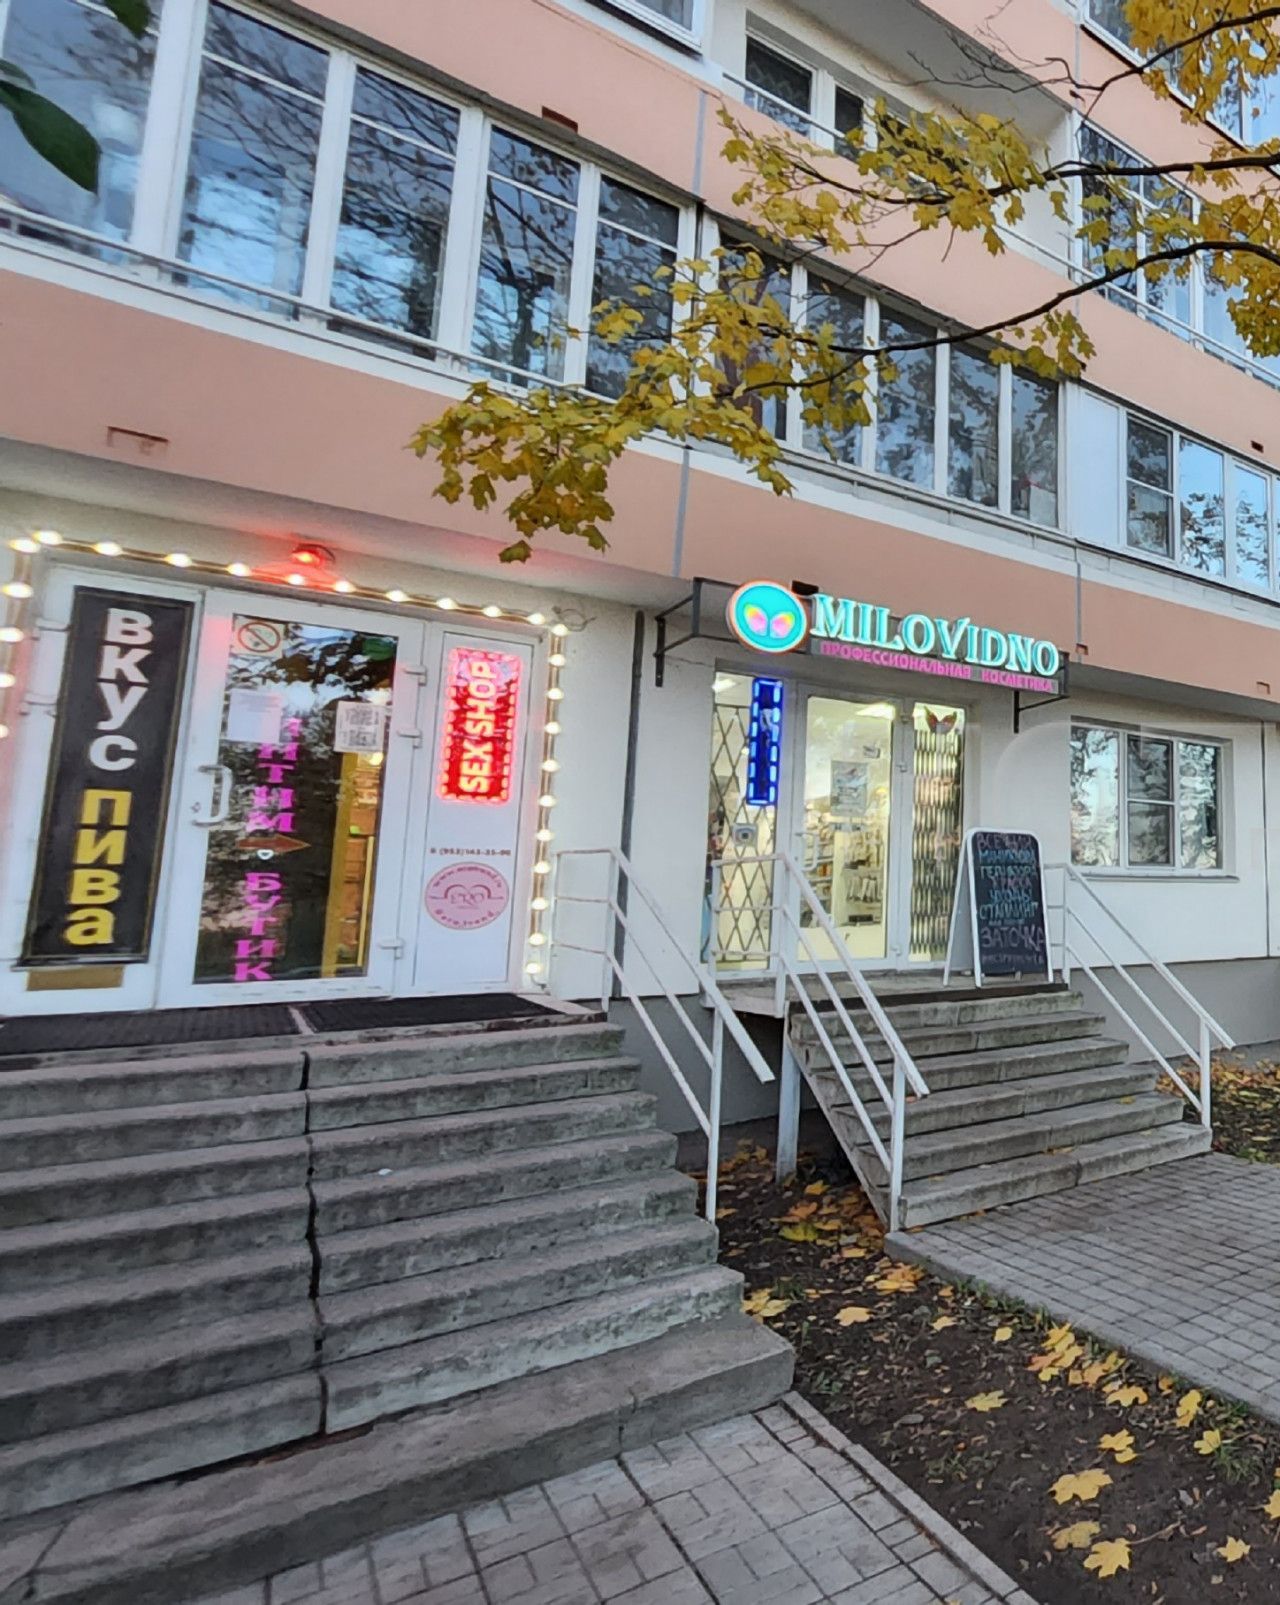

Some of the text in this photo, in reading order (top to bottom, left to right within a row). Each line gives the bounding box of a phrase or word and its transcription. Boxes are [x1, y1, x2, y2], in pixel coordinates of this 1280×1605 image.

[809, 593, 1060, 677] MILOVIDNO
[820, 641, 1054, 692] ПРОФЕССИОНАЛЬНАЯ КОСМЕТИКА
[457, 660, 498, 793] SEX SHOP
[234, 872, 283, 982] БУТИК
[980, 924, 1045, 952] ЗАТОЧКА
